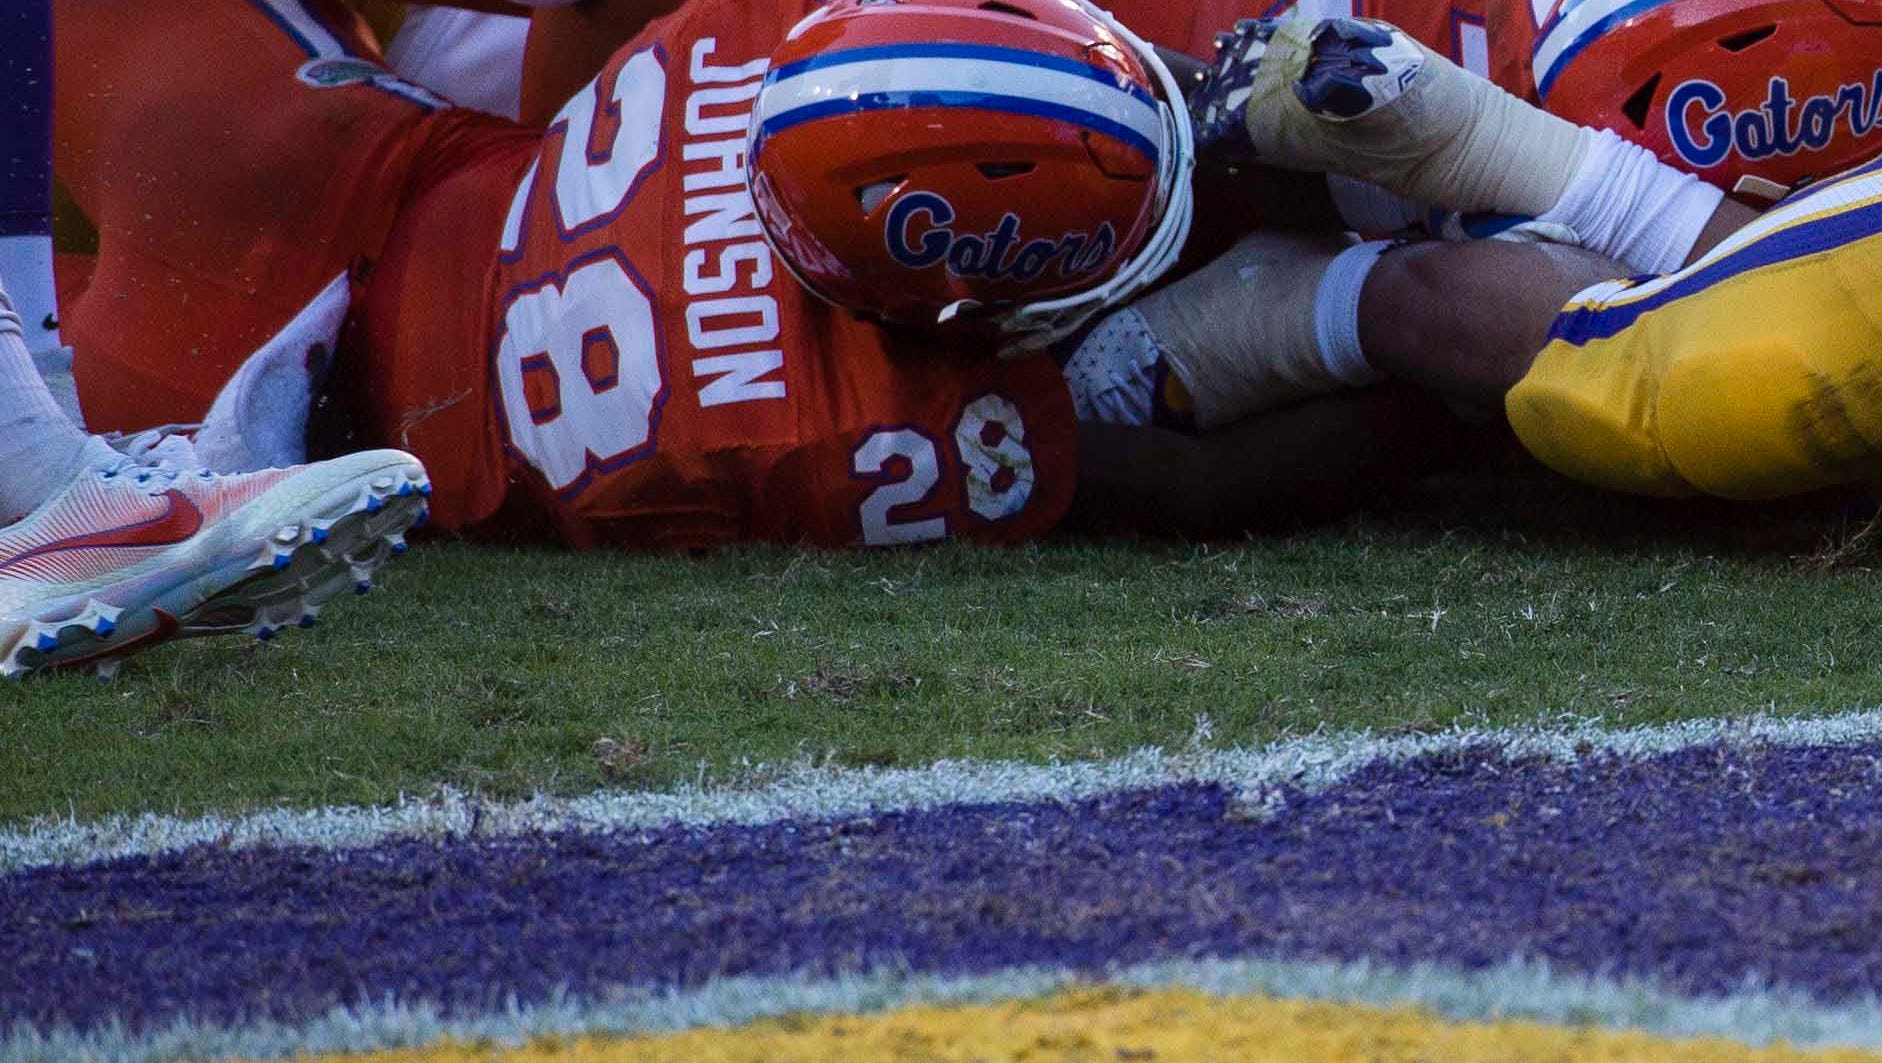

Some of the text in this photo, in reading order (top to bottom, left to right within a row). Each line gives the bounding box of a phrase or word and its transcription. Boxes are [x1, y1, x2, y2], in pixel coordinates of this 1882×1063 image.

[682, 36, 788, 408] JOHNSON
[884, 191, 1116, 281] Gators
[848, 393, 1038, 548] 28
